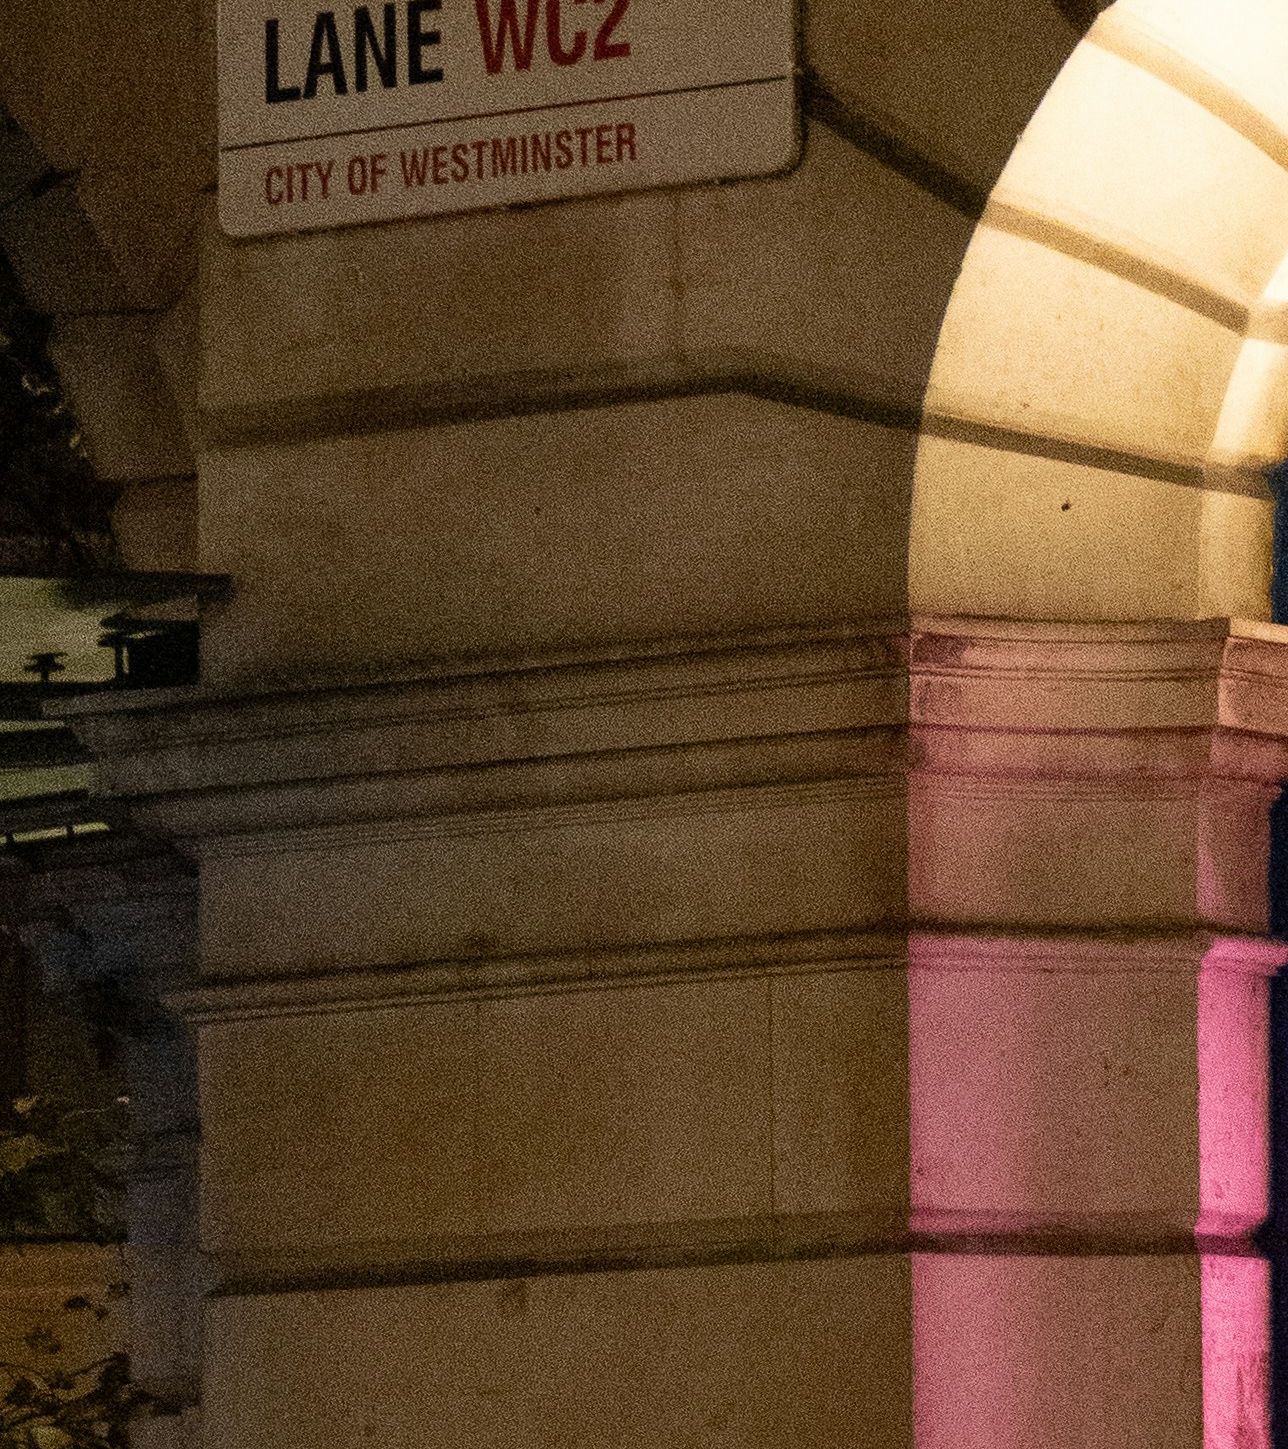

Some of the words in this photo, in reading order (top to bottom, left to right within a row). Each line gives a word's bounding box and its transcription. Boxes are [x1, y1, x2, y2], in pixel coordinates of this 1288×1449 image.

[263, 161, 334, 207] CITY
[347, 153, 387, 196] OF
[401, 122, 638, 189] WESTMINSTER
